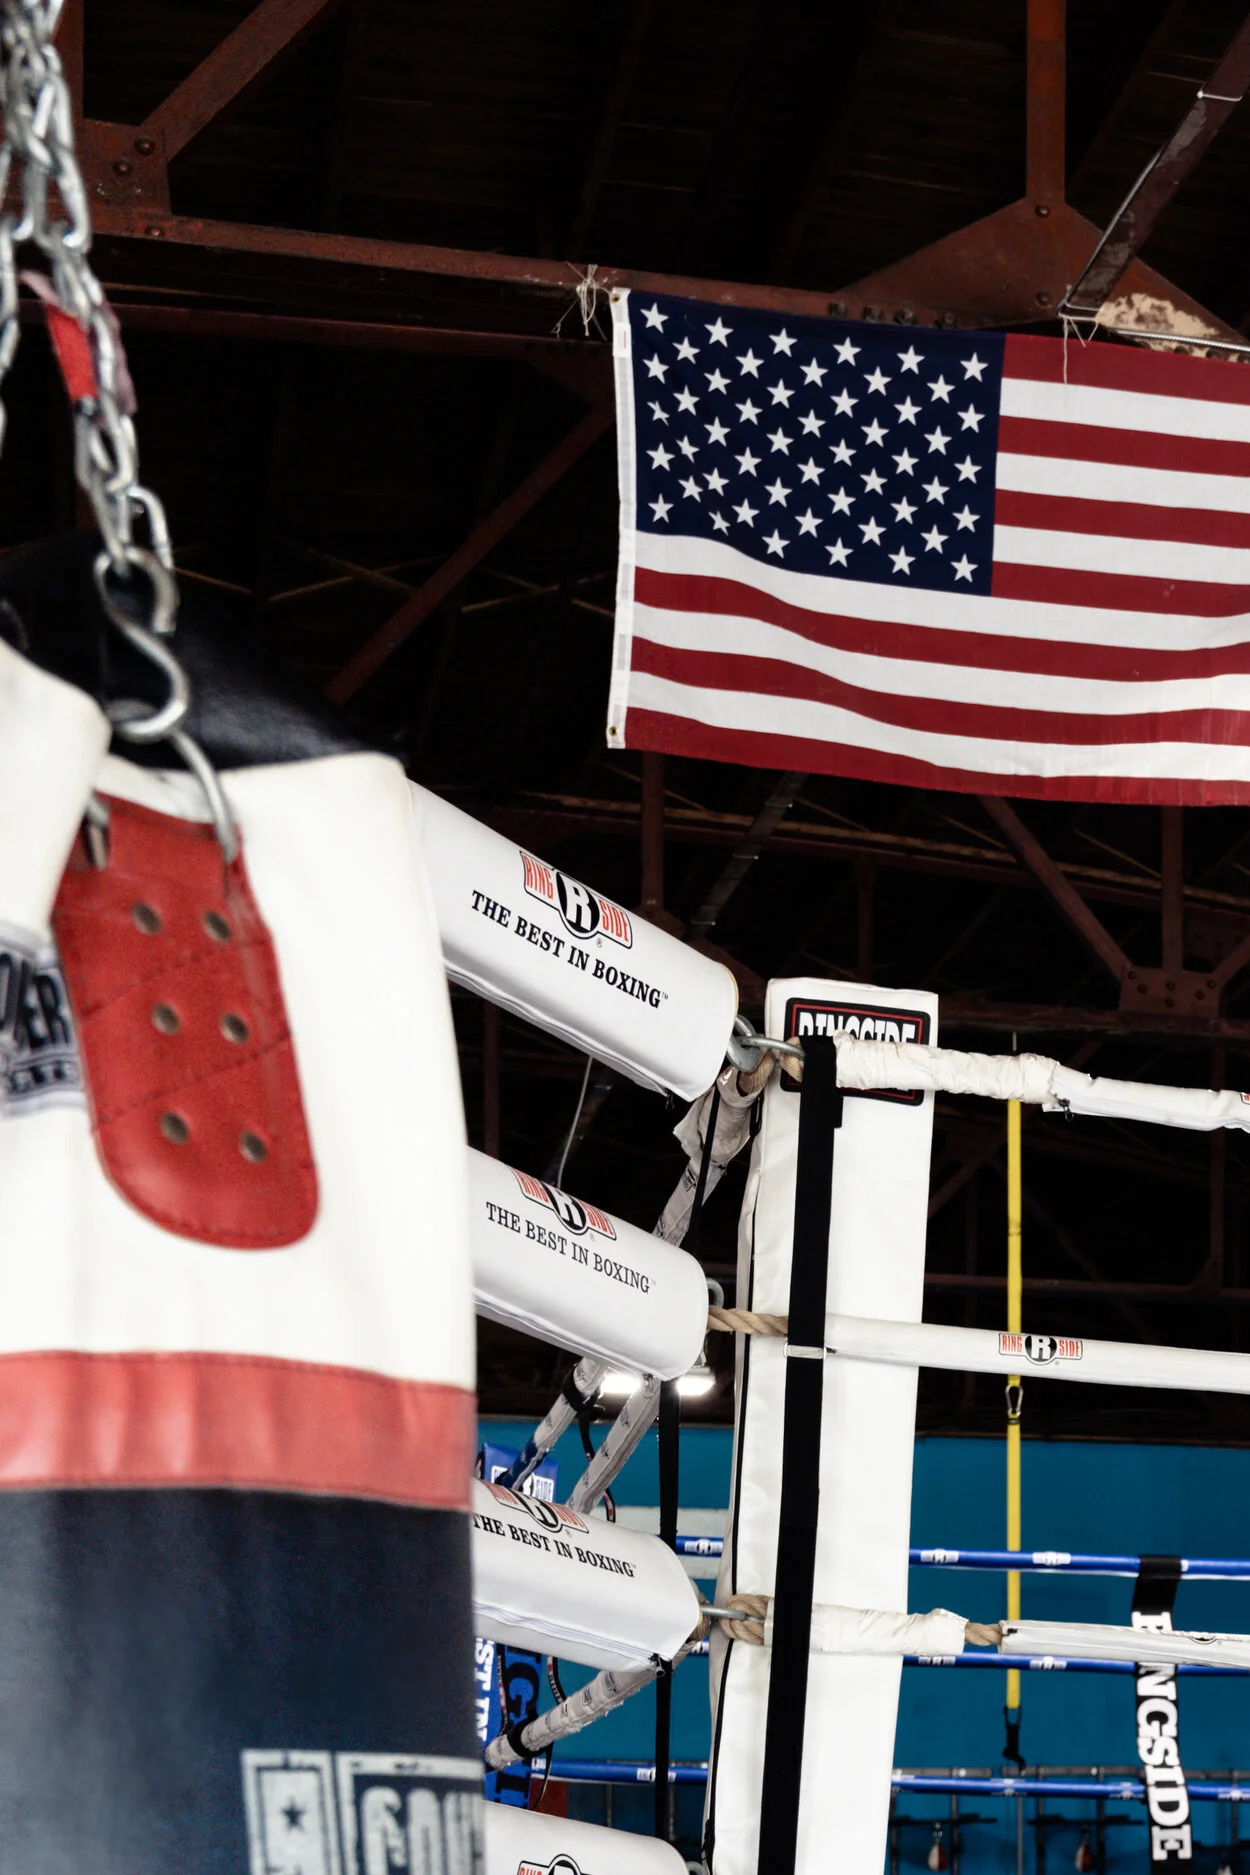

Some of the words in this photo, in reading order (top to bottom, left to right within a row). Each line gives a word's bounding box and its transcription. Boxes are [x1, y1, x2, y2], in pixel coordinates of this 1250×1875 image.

[522, 855, 554, 900] RING
[558, 872, 593, 931] R
[598, 899, 630, 942] SIDE
[471, 889, 511, 928] THE
[514, 915, 565, 957] BEST
[567, 945, 590, 971] IN
[592, 958, 661, 1009] BOXING
[486, 1201, 521, 1233] THE
[525, 1219, 567, 1255] BEST
[571, 1241, 589, 1266] IN
[593, 1252, 650, 1294] BOXING
[1031, 1336, 1051, 1362] R
[473, 1513, 506, 1537] THE
[511, 1524, 551, 1552] BEST
[553, 1538, 573, 1559] IN
[574, 1547, 635, 1578] BOXING
